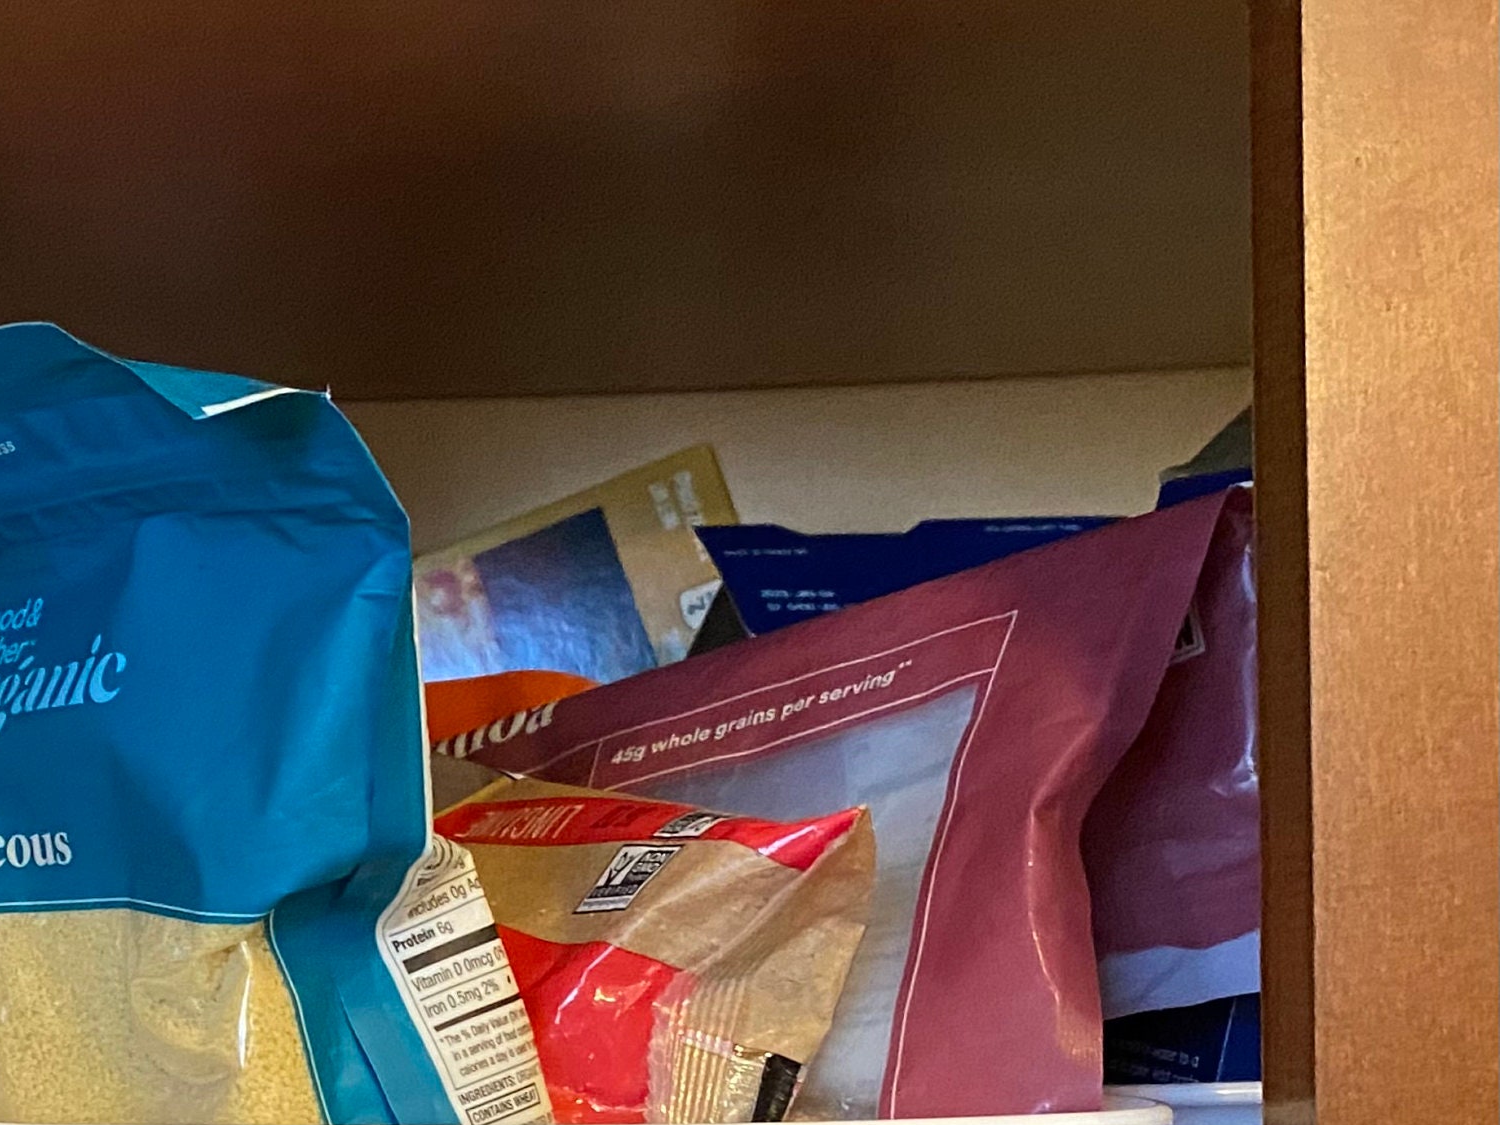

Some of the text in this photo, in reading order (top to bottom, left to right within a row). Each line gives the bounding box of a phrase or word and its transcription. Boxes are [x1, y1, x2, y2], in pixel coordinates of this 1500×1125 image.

[611, 745, 646, 765] 45g
[651, 728, 711, 754] whole
[714, 708, 776, 740] grains
[780, 694, 816, 722] per
[392, 920, 454, 953] Protein 6g
[411, 968, 454, 992] Vitamin
[453, 961, 463, 976] D
[423, 978, 500, 1018] Iron 0.5mg 2%
[472, 1099, 514, 1125] CONTAINS
